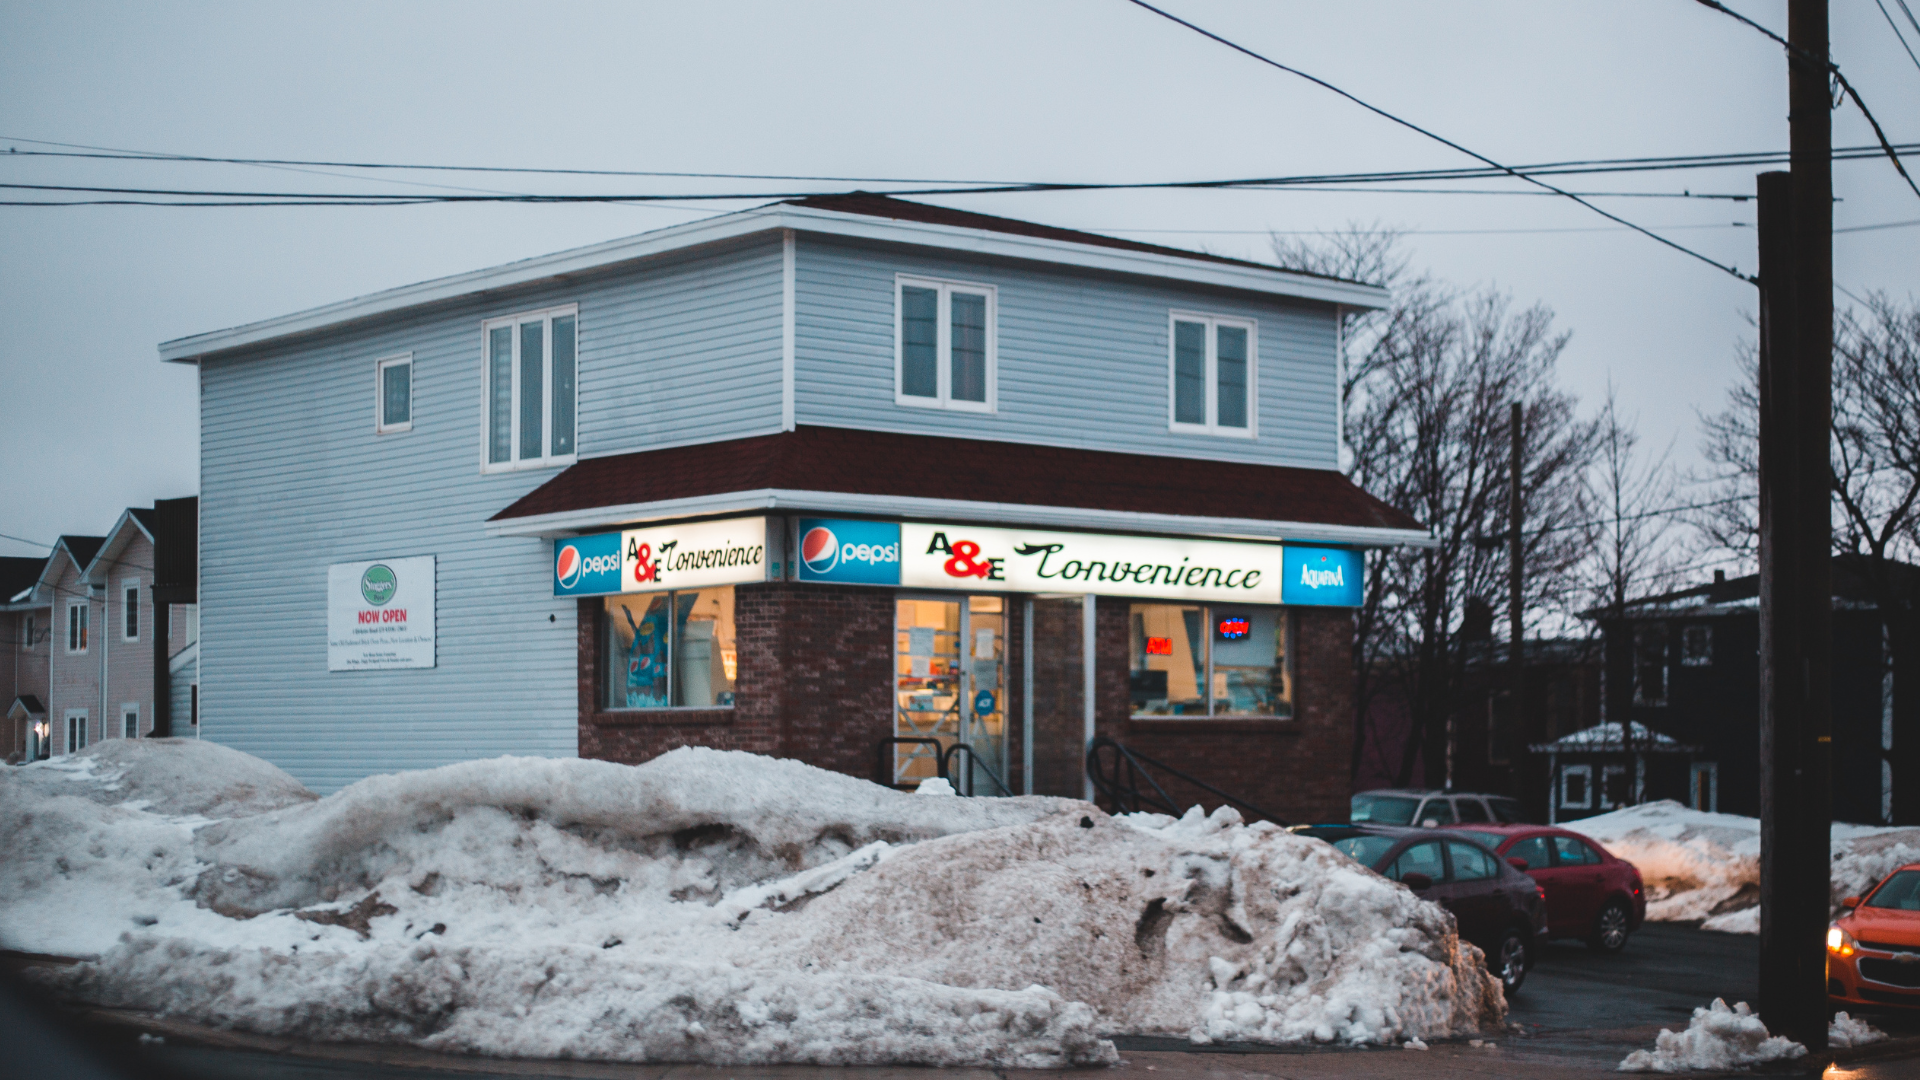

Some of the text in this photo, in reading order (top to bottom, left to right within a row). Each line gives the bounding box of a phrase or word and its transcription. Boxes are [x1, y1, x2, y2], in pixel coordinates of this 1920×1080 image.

[582, 550, 621, 578] pepsi
[658, 539, 763, 572] Convenience
[841, 541, 900, 566] pepsi
[1013, 541, 1263, 589] Convenience
[358, 608, 407, 624] NOW OPEN
[1145, 636, 1173, 655] ATM
